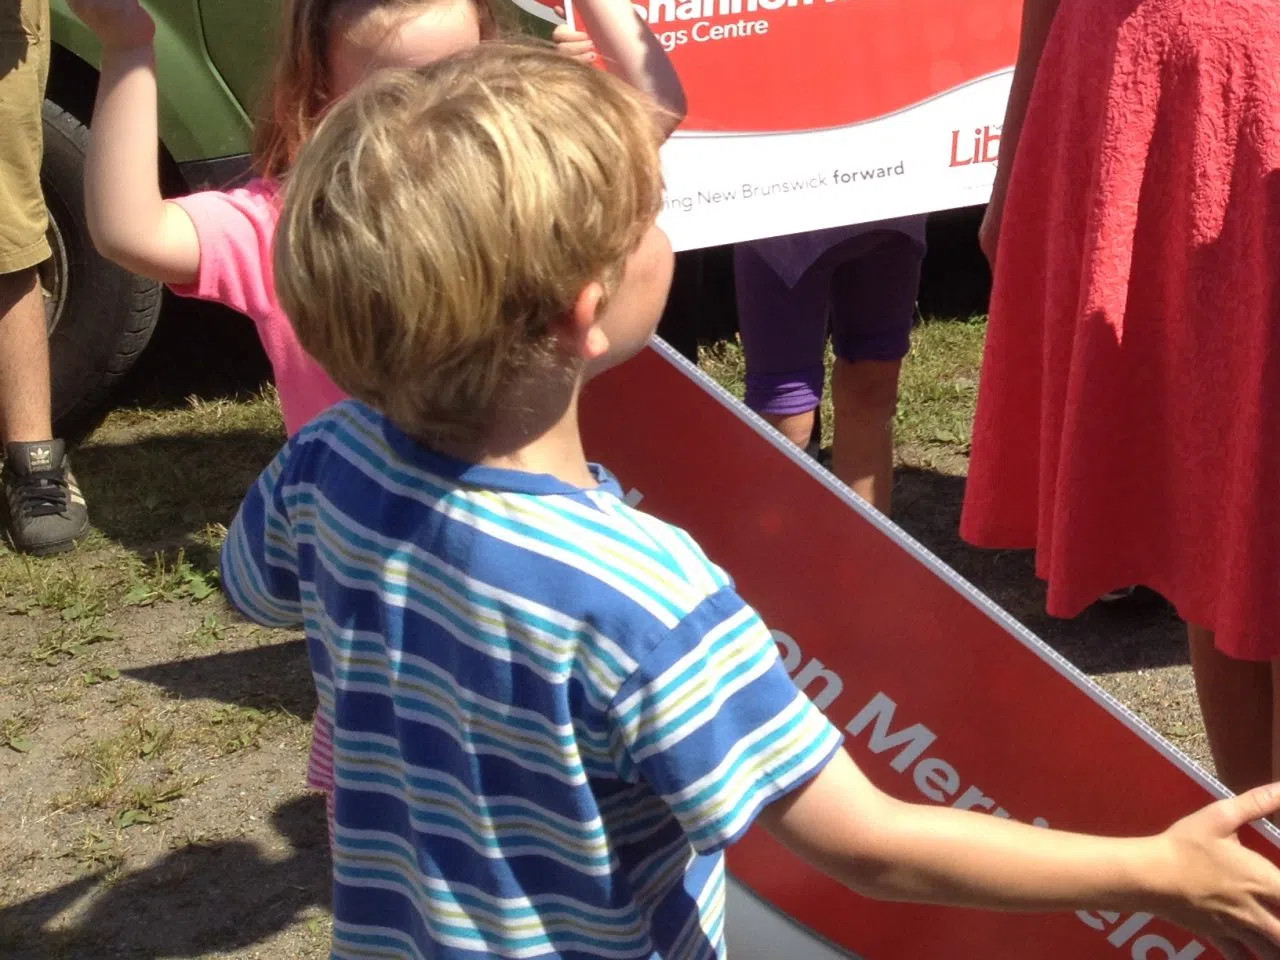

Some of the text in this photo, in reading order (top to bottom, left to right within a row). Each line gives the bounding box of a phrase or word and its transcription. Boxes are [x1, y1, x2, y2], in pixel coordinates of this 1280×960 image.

[692, 19, 769, 42] Centre
[697, 188, 738, 206] New
[742, 172, 828, 201] Brunswick
[833, 161, 906, 186] forward
